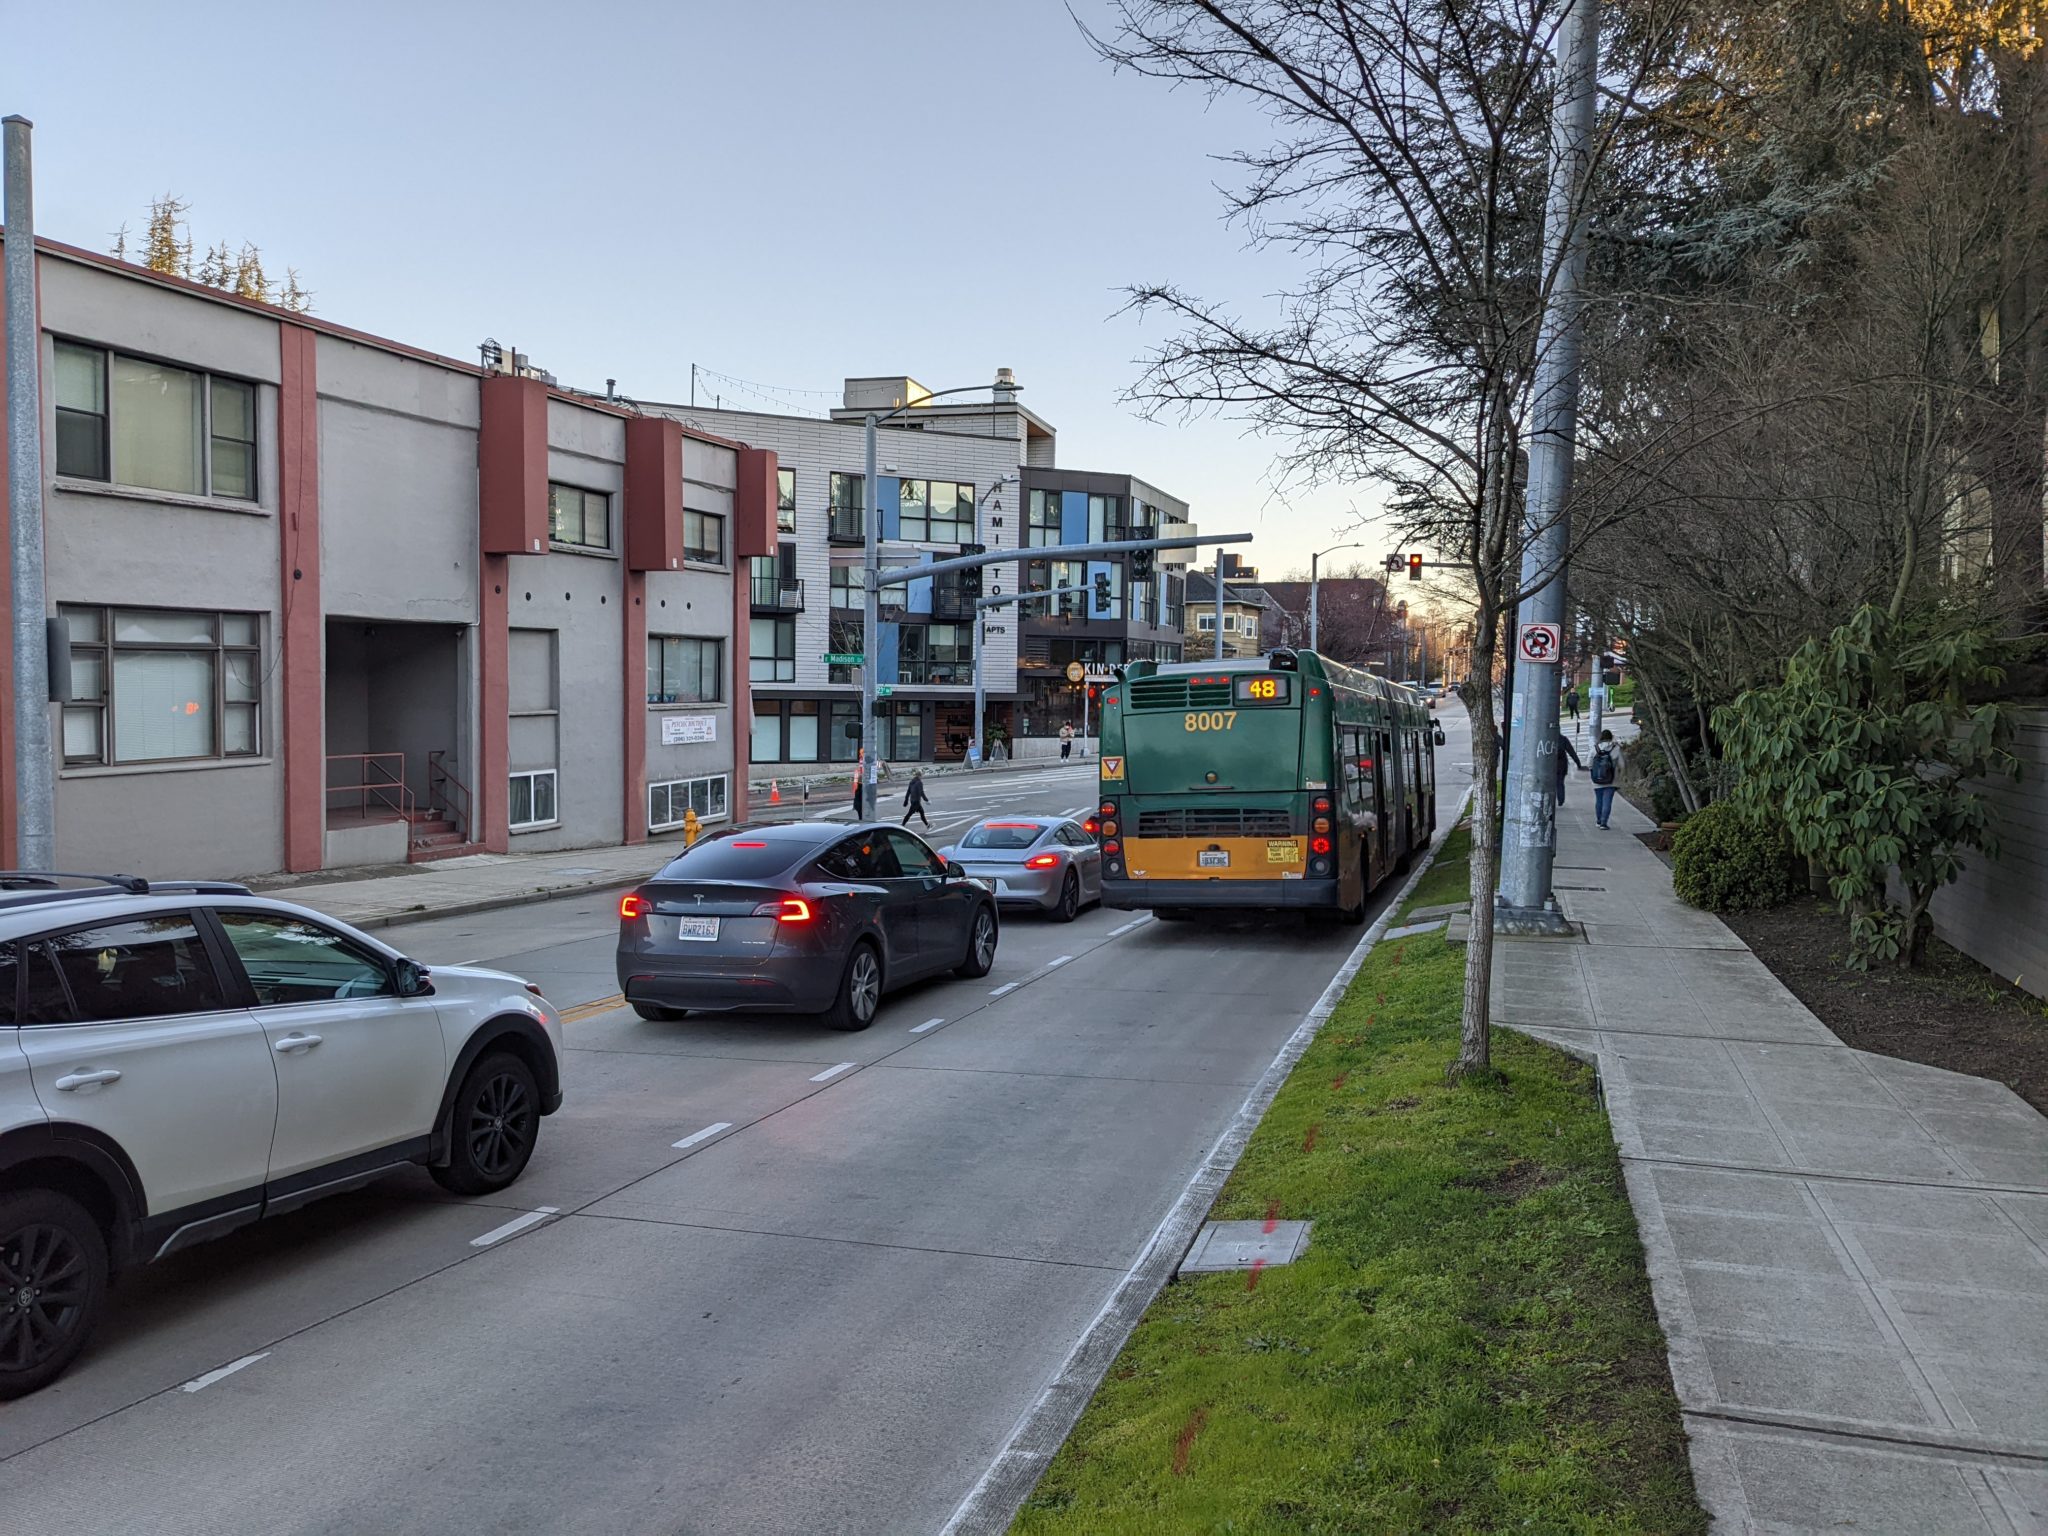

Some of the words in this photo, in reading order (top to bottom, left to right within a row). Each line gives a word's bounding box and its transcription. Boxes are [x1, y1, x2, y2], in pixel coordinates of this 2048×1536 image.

[992, 482, 1003, 613] HAMITON
[985, 626, 1006, 634] APTS
[830, 655, 855, 663] Madison
[1249, 680, 1276, 698] 48
[1184, 711, 1237, 732] 8007
